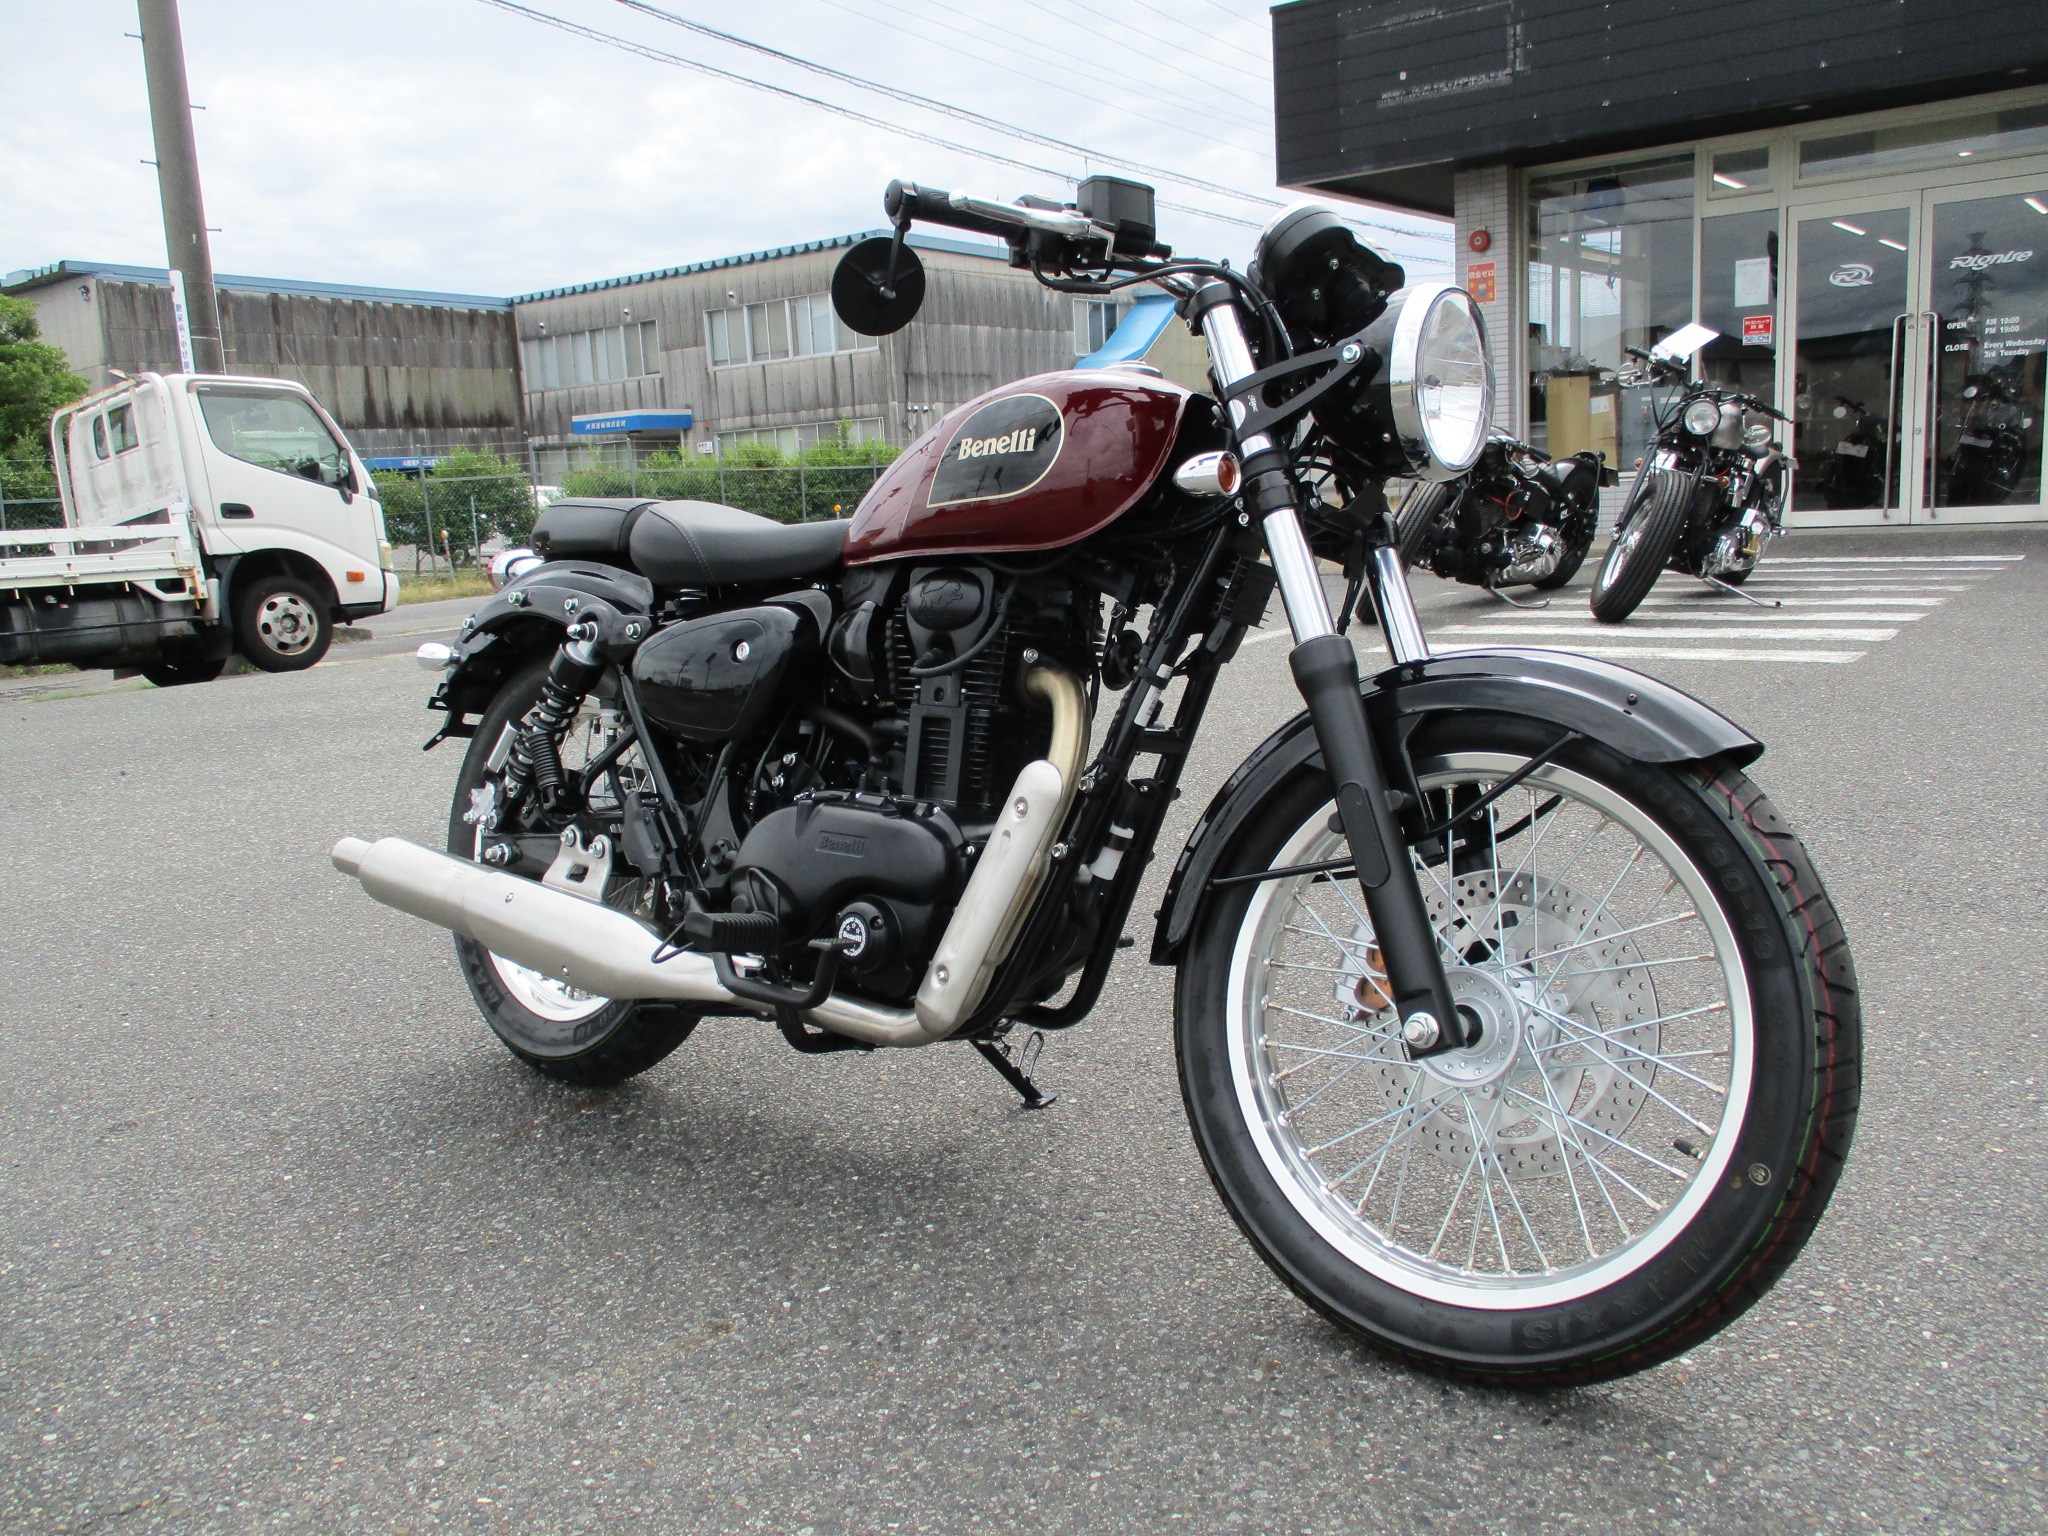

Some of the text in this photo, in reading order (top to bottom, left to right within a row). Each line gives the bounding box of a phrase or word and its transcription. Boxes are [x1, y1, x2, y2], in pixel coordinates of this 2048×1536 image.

[1947, 322, 1967, 330] OPEN
[1985, 317, 2020, 326] AM 10:00
[1984, 325, 2020, 335] PM 19:00
[175, 304, 190, 373] 糖尿病・甲状腺
[1983, 338, 2046, 350] Every Wednesday
[1945, 343, 1969, 352] CLOSE
[1984, 347, 2030, 358] 3rd Tuesday
[957, 428, 1036, 461] Benelli
[820, 836, 865, 854] Benelli
[1640, 771, 1775, 960] 00/90-19
[842, 930, 862, 943] Benelli
